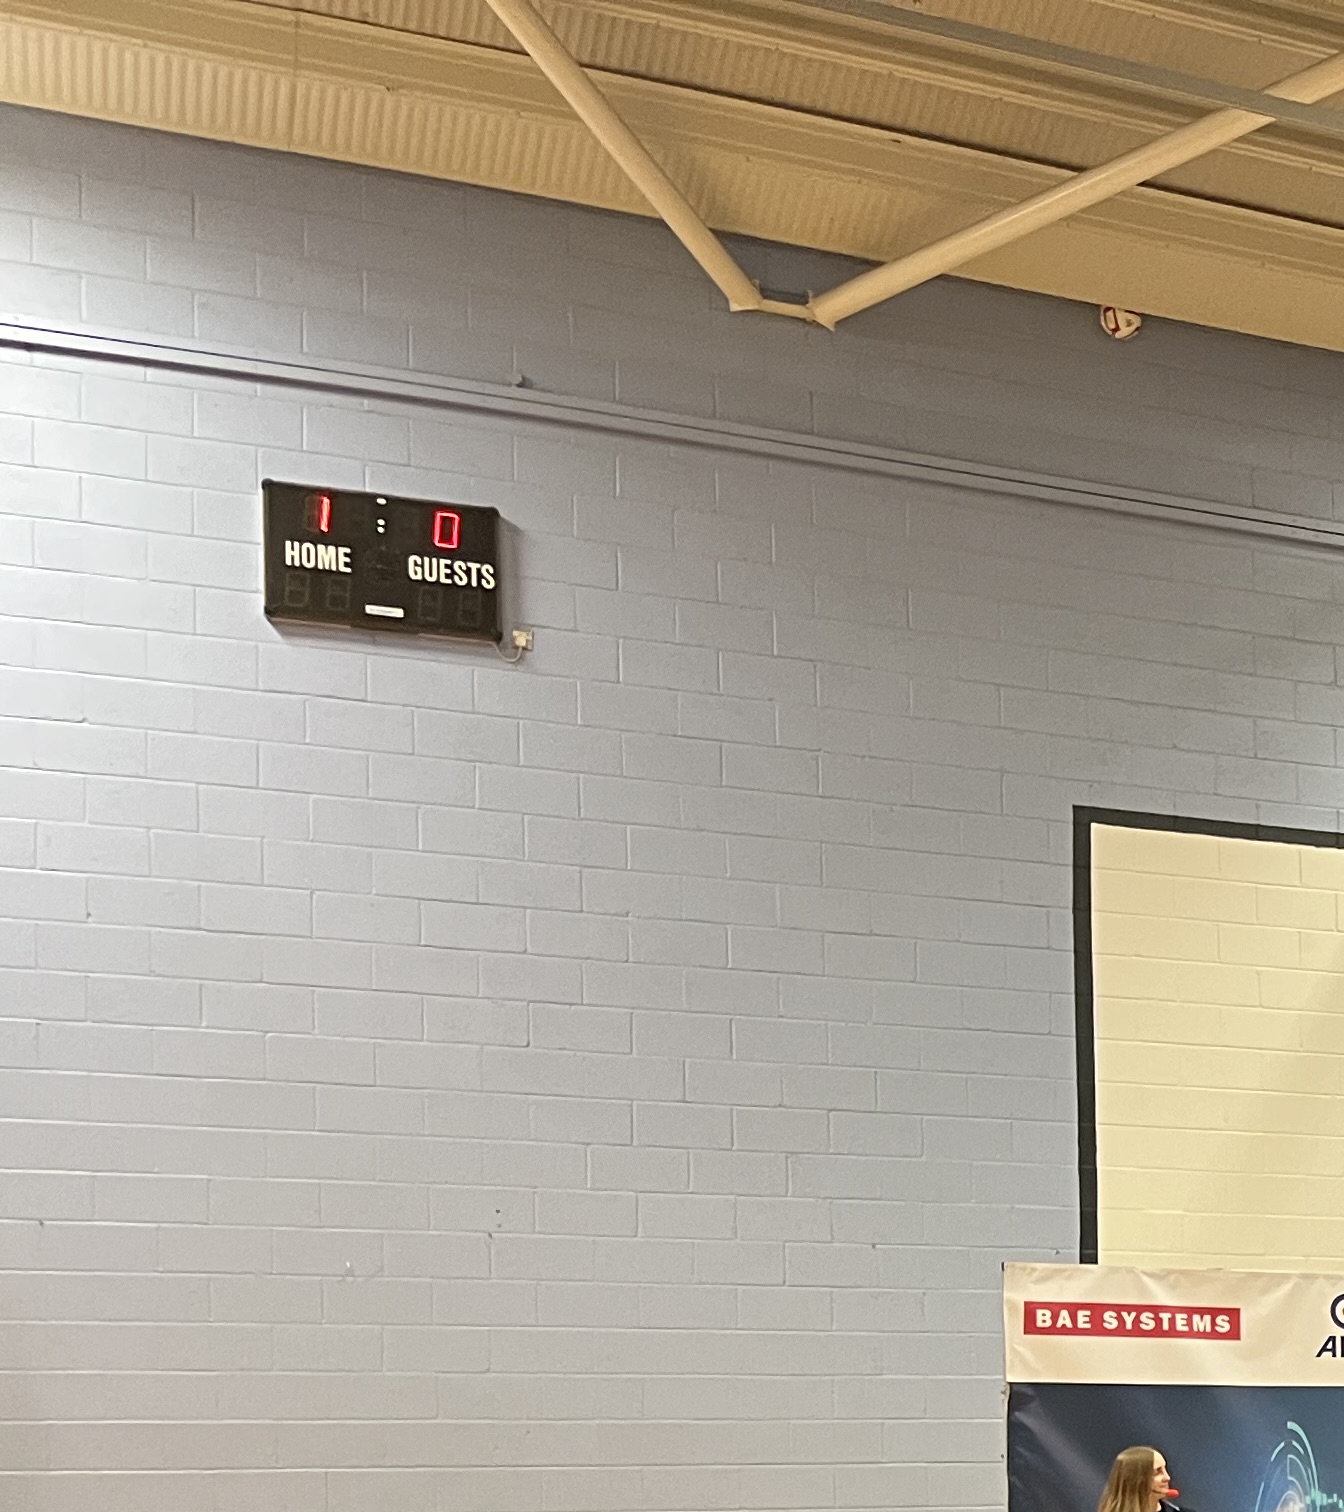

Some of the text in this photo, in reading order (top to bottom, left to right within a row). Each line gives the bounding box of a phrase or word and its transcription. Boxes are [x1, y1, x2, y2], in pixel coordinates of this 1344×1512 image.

[318, 495, 461, 549] 1 0
[284, 540, 352, 574] HOME
[408, 554, 496, 590] GUESTS
[1035, 1308, 1231, 1334] BAE SYSTEMS
